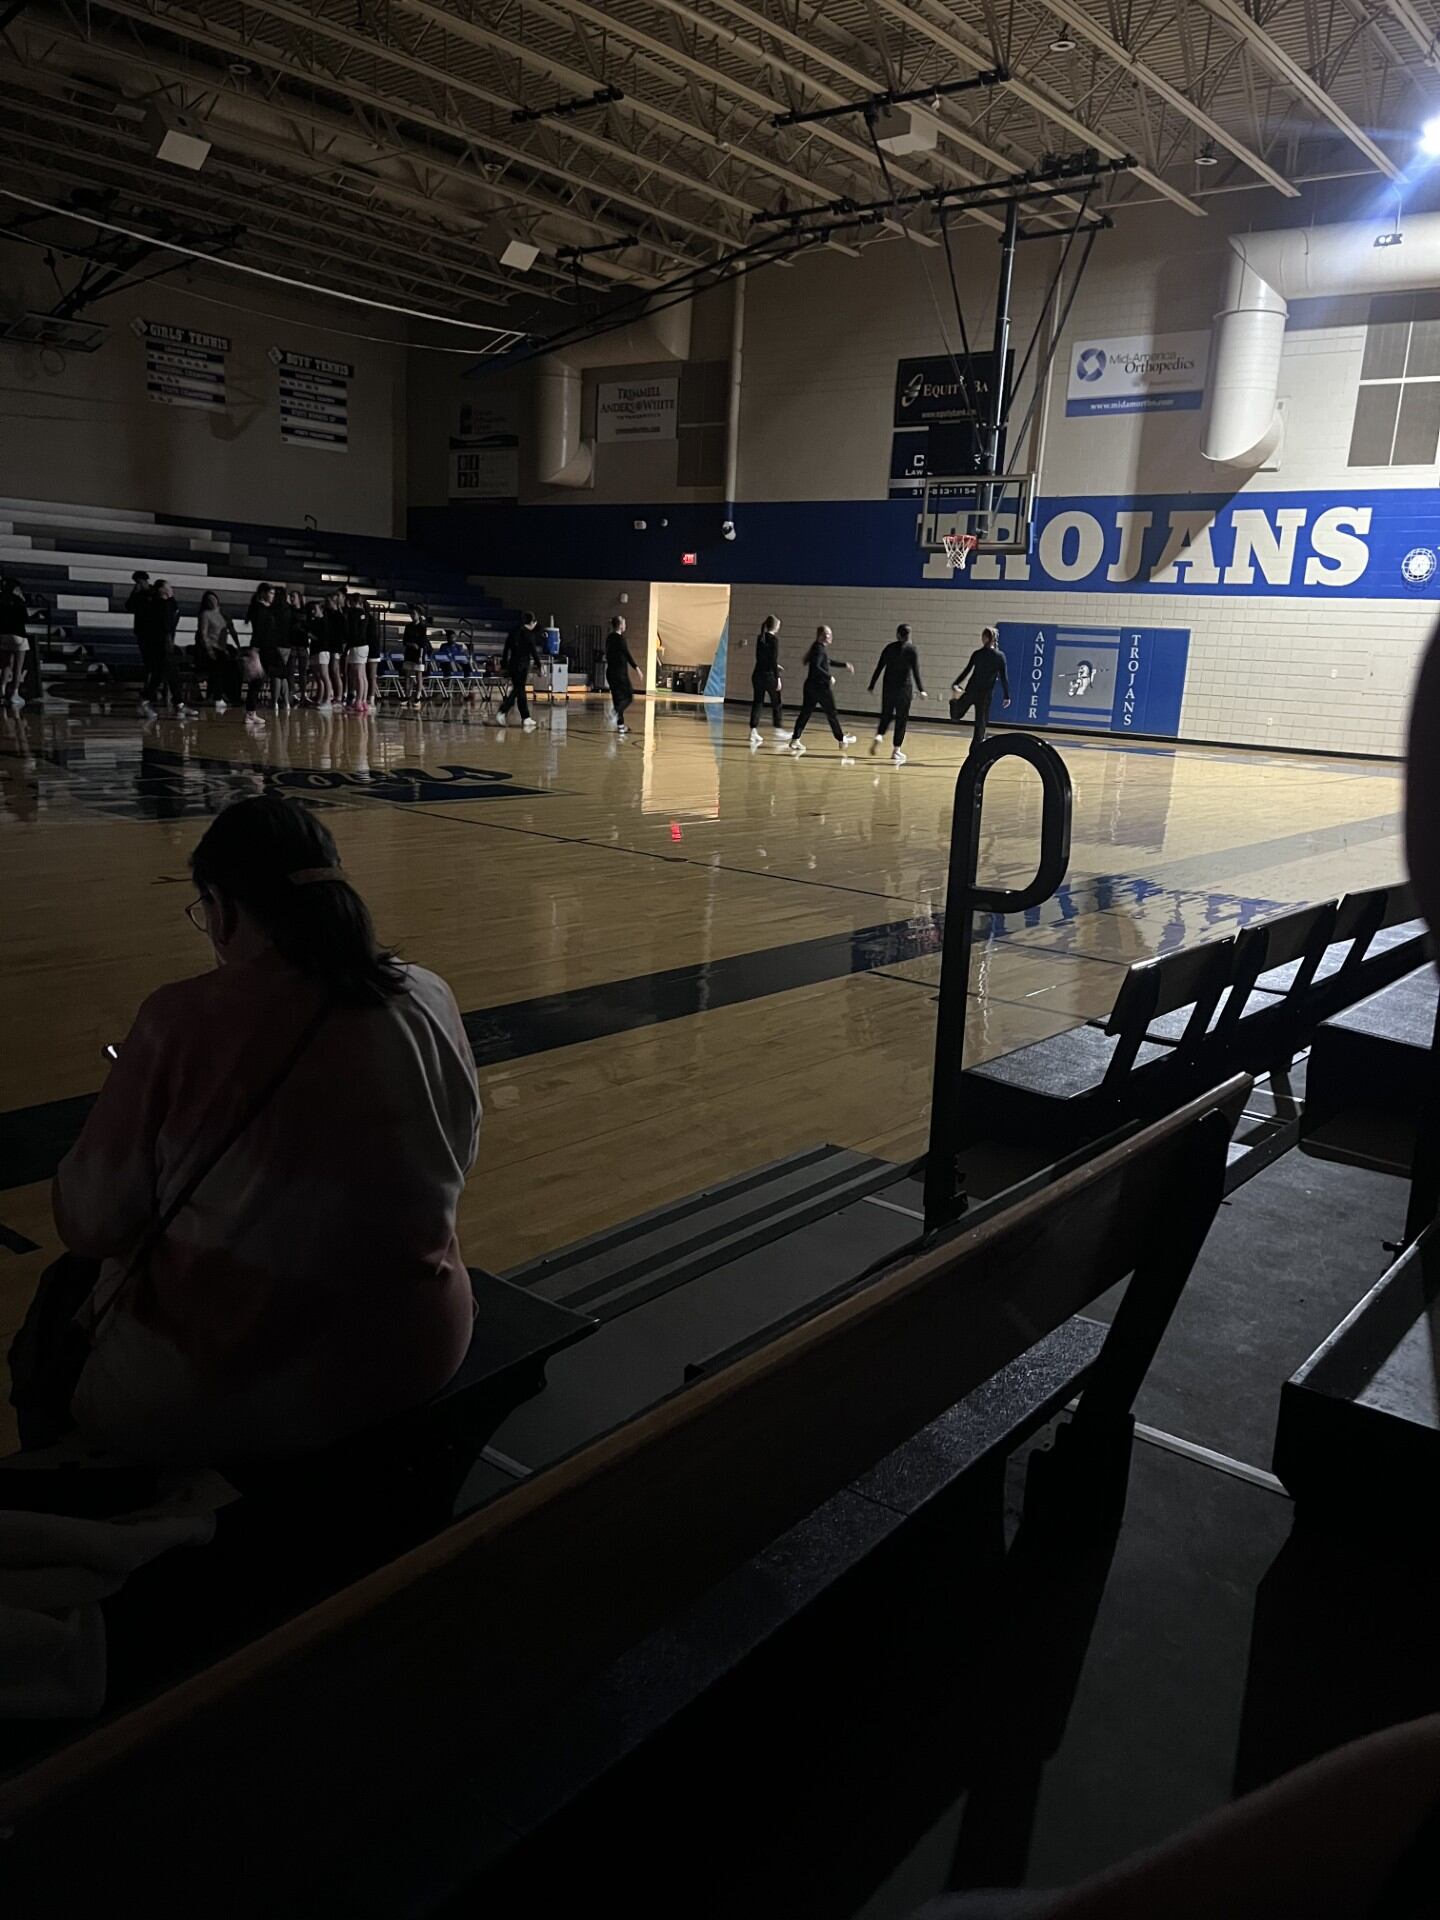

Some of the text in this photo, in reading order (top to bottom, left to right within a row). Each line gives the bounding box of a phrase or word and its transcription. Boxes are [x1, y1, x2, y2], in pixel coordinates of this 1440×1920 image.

[1124, 357, 1196, 375] Orthopedics
[916, 506, 1373, 587] TROJANS
[1028, 630, 1046, 720] ANDOVER
[1122, 633, 1142, 727] TROJANS
